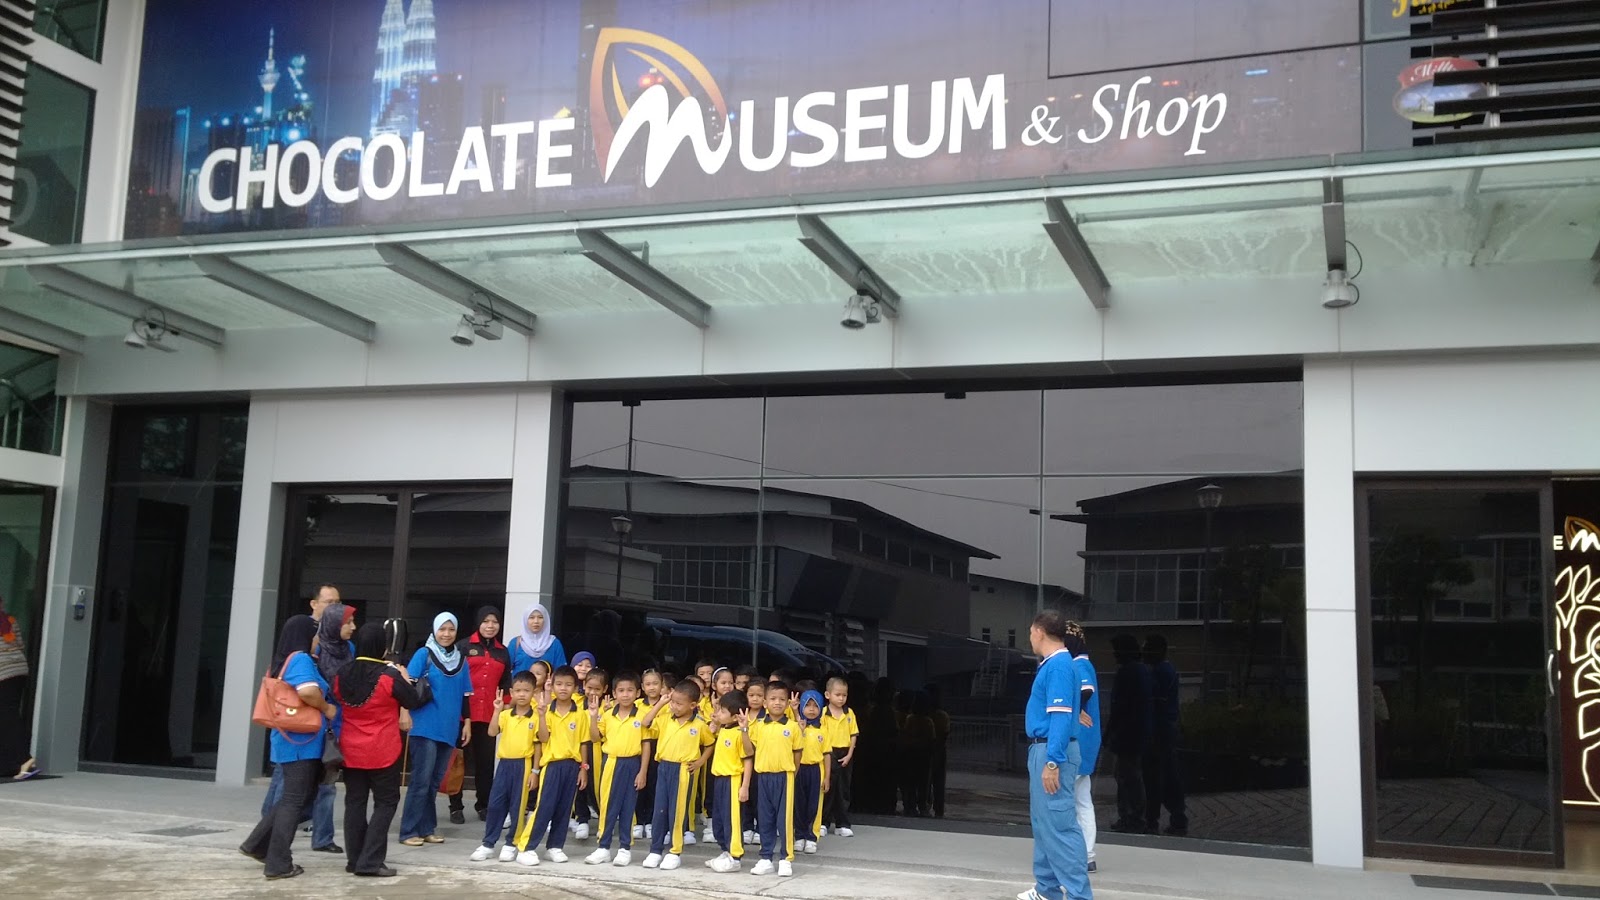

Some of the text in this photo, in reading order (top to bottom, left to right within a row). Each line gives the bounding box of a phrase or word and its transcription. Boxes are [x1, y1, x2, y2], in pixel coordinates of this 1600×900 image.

[198, 74, 1228, 213] CHOCOLATE MUSEUM & Shop
